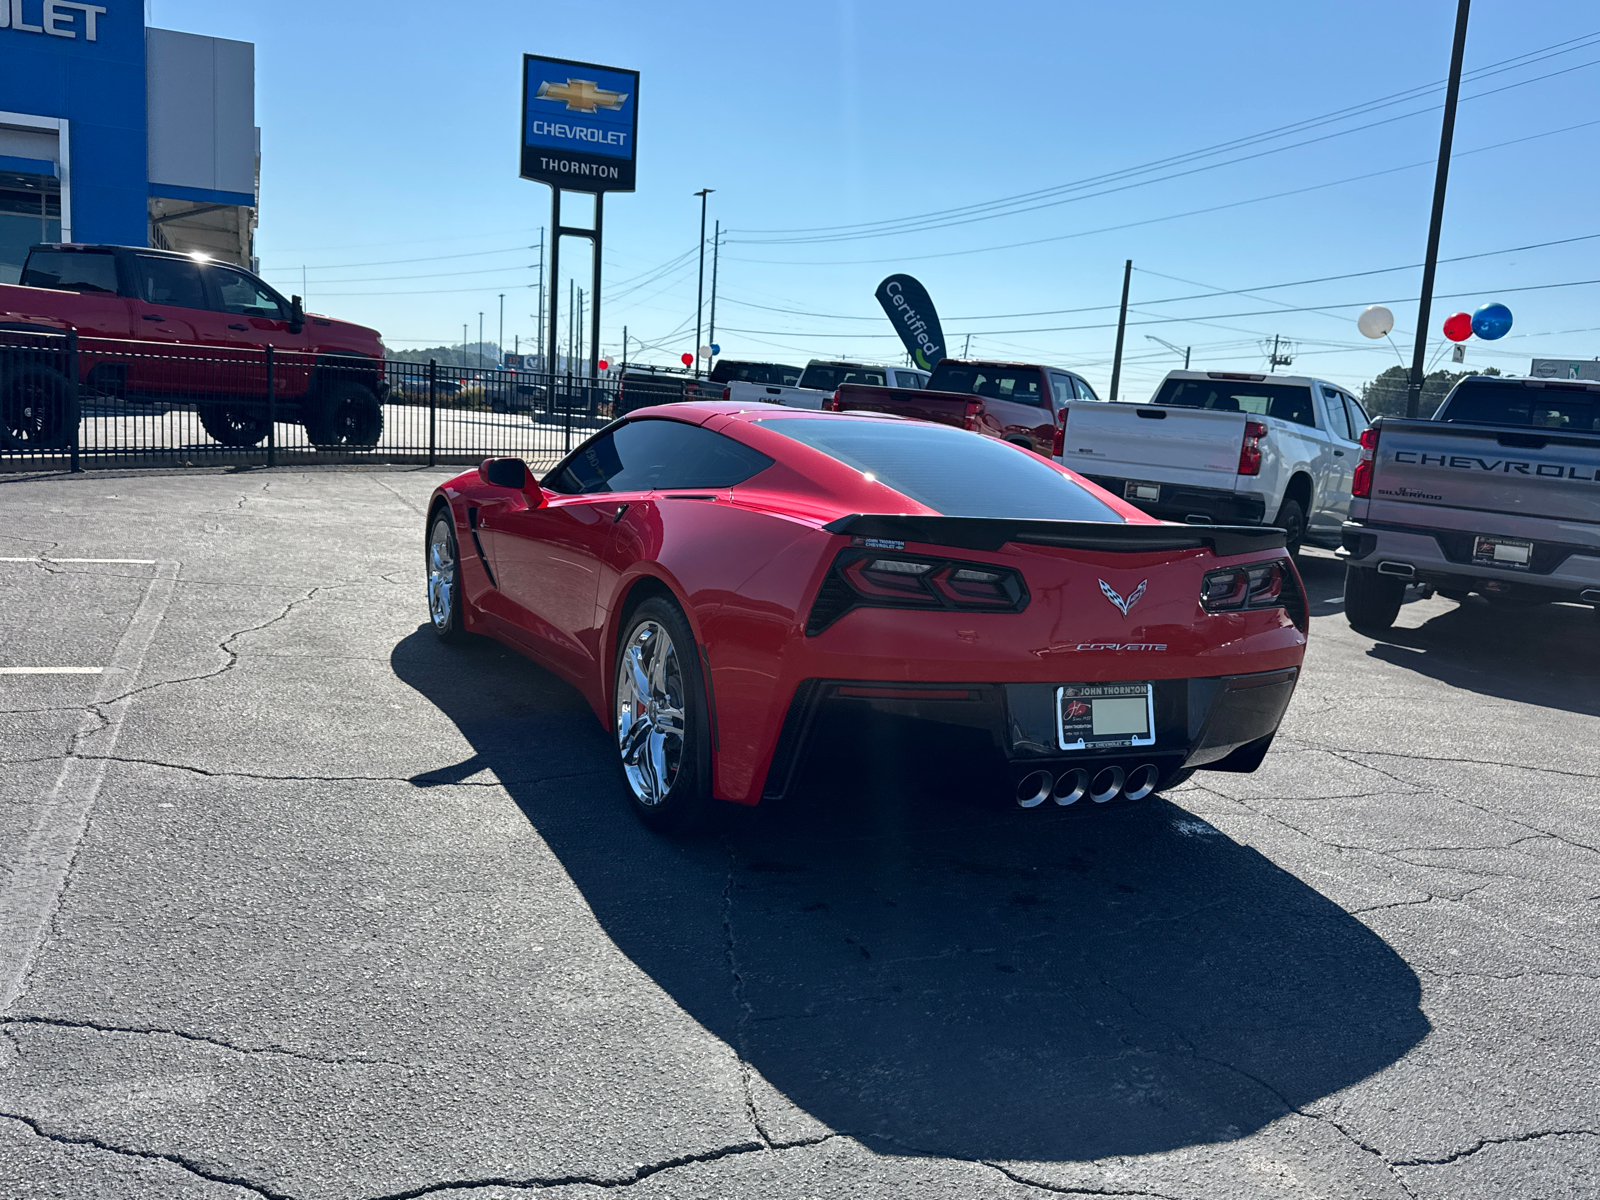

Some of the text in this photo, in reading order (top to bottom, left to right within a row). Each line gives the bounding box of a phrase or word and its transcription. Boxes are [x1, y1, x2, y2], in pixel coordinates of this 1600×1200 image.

[533, 120, 627, 146] CHEVROLET
[540, 157, 618, 179] THORNTON
[886, 281, 940, 356] Certified
[1395, 451, 1600, 482] CHEVROL
[1378, 489, 1442, 501] SILVERADO
[1076, 643, 1167, 651] CORVETTE
[1080, 685, 1147, 696] JOHN THORNTON
